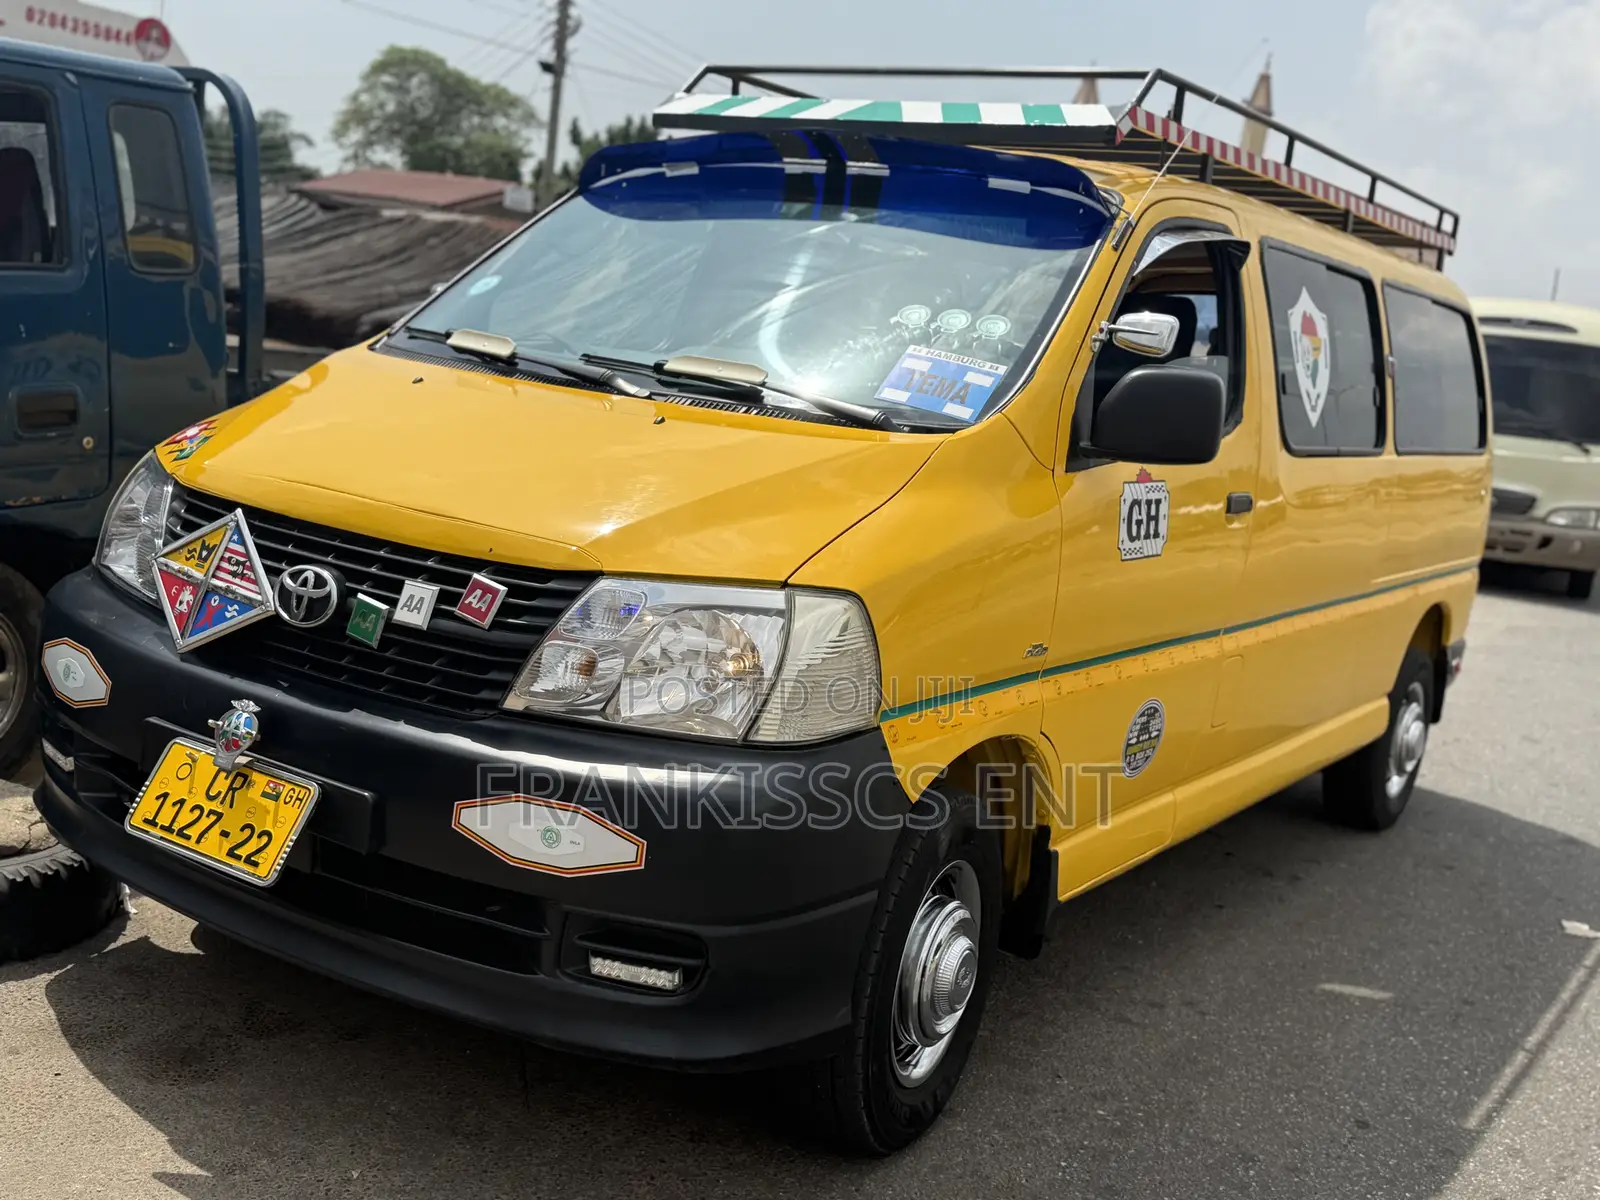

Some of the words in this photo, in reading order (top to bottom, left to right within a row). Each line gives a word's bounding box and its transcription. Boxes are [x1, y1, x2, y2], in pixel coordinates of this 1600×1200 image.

[925, 348, 987, 369] HAMBURG
[903, 368, 972, 405] TEMA
[1126, 498, 1162, 543] GH
[400, 593, 425, 615] AA
[463, 588, 493, 612] AA
[352, 608, 377, 633] AA
[205, 768, 249, 809] CR
[283, 787, 308, 810] GH
[142, 791, 273, 868] 1127-22
